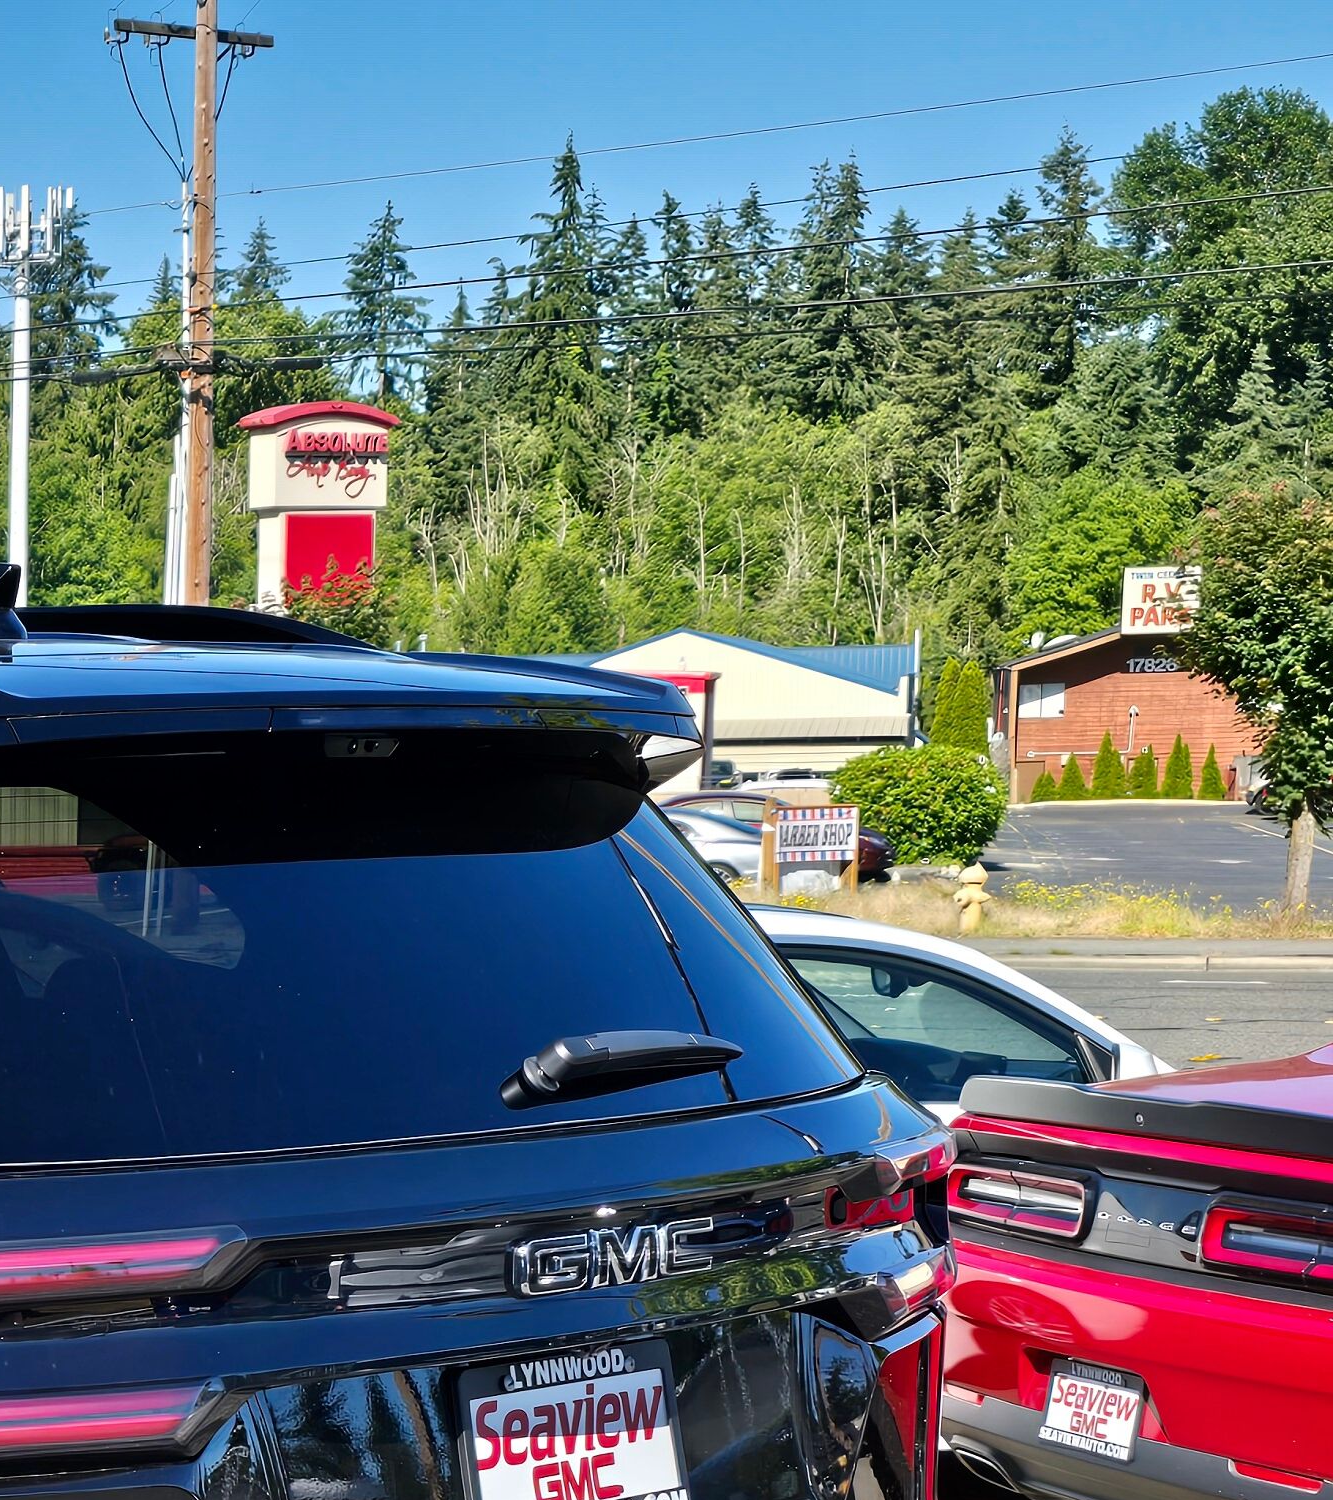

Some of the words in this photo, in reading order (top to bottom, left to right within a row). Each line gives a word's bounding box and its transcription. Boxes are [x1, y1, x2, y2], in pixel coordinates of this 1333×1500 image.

[285, 430, 388, 451] ABSOLUTE
[822, 823, 853, 846] SHOP
[510, 1216, 714, 1297] GMC
[509, 1348, 625, 1390] LYNNWOOD
[1052, 1376, 1139, 1422] Seaview
[475, 1383, 663, 1471] Seaview
[1070, 1410, 1108, 1440] GMC
